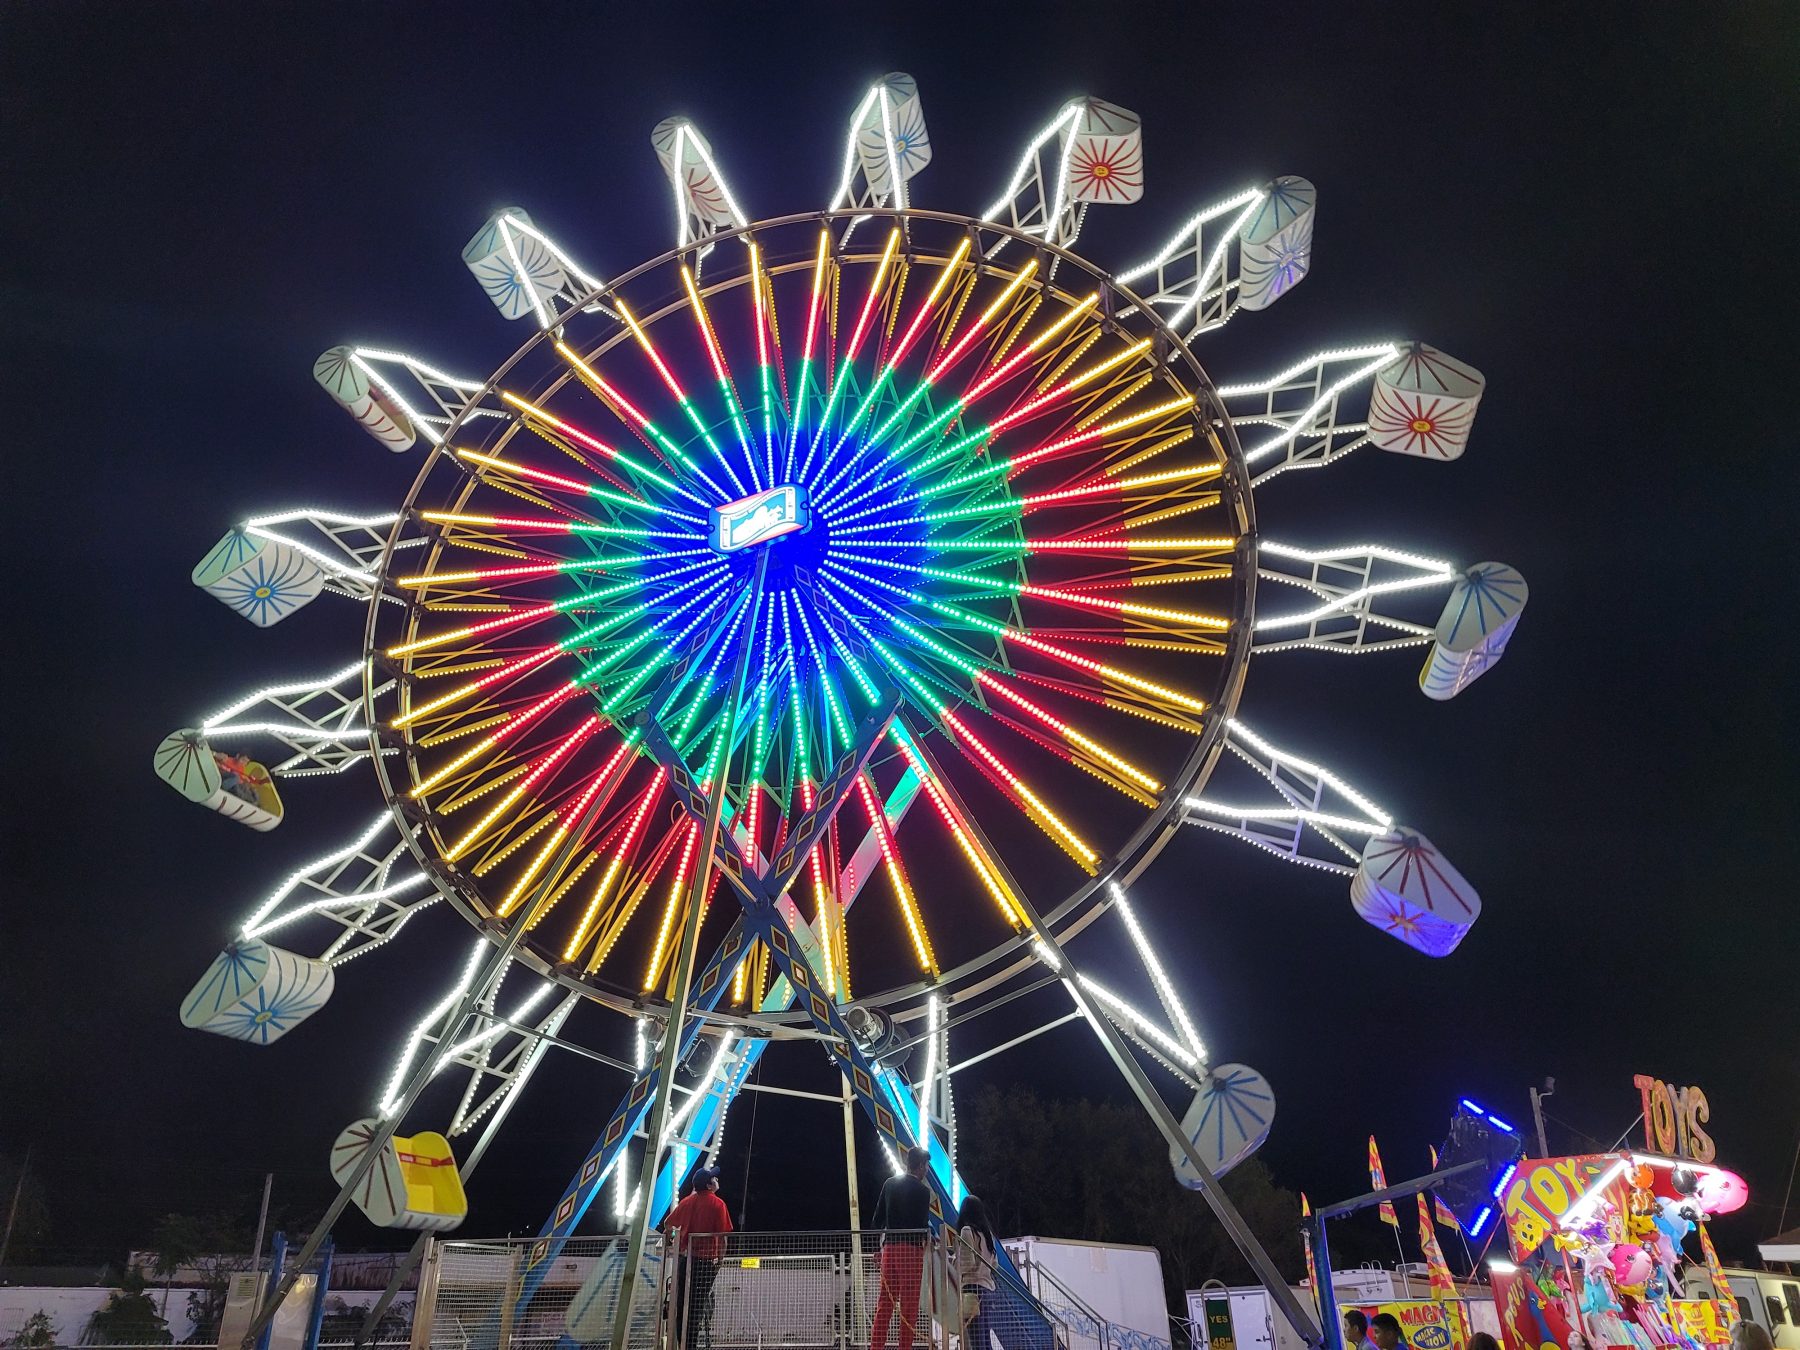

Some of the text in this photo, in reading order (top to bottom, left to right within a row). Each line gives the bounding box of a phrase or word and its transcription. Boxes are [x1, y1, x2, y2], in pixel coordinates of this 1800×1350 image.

[1633, 1074, 1716, 1164] TOYS
[1506, 1158, 1585, 1231] TOY
[1209, 1315, 1228, 1324] YES
